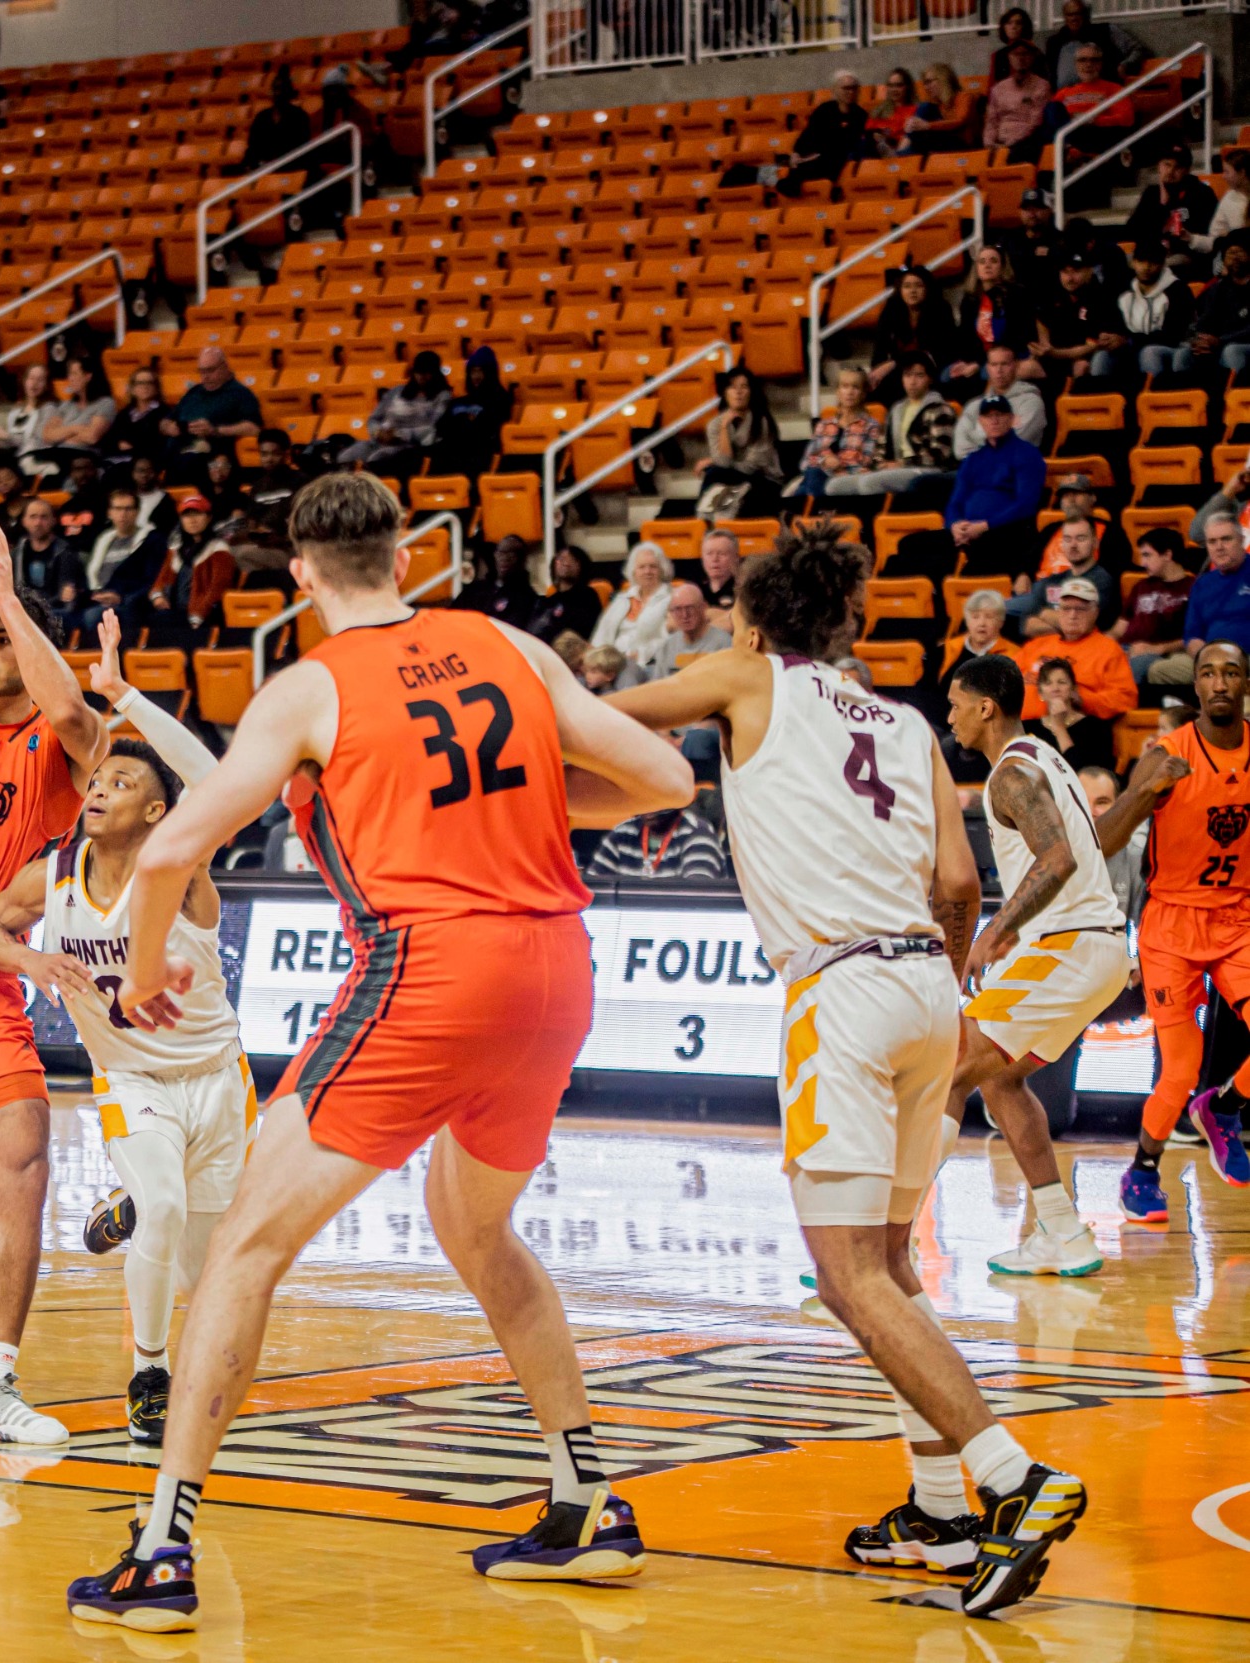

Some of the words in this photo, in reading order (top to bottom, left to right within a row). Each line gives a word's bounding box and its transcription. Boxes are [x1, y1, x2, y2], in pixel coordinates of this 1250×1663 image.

[398, 653, 469, 690] CRAIG
[406, 681, 527, 811] 32
[843, 732, 896, 822] 4
[1198, 855, 1239, 887] 25
[61, 936, 129, 965] WINTH
[271, 929, 355, 973] REB
[623, 938, 777, 986] FOULS
[674, 1014, 706, 1062] 3
